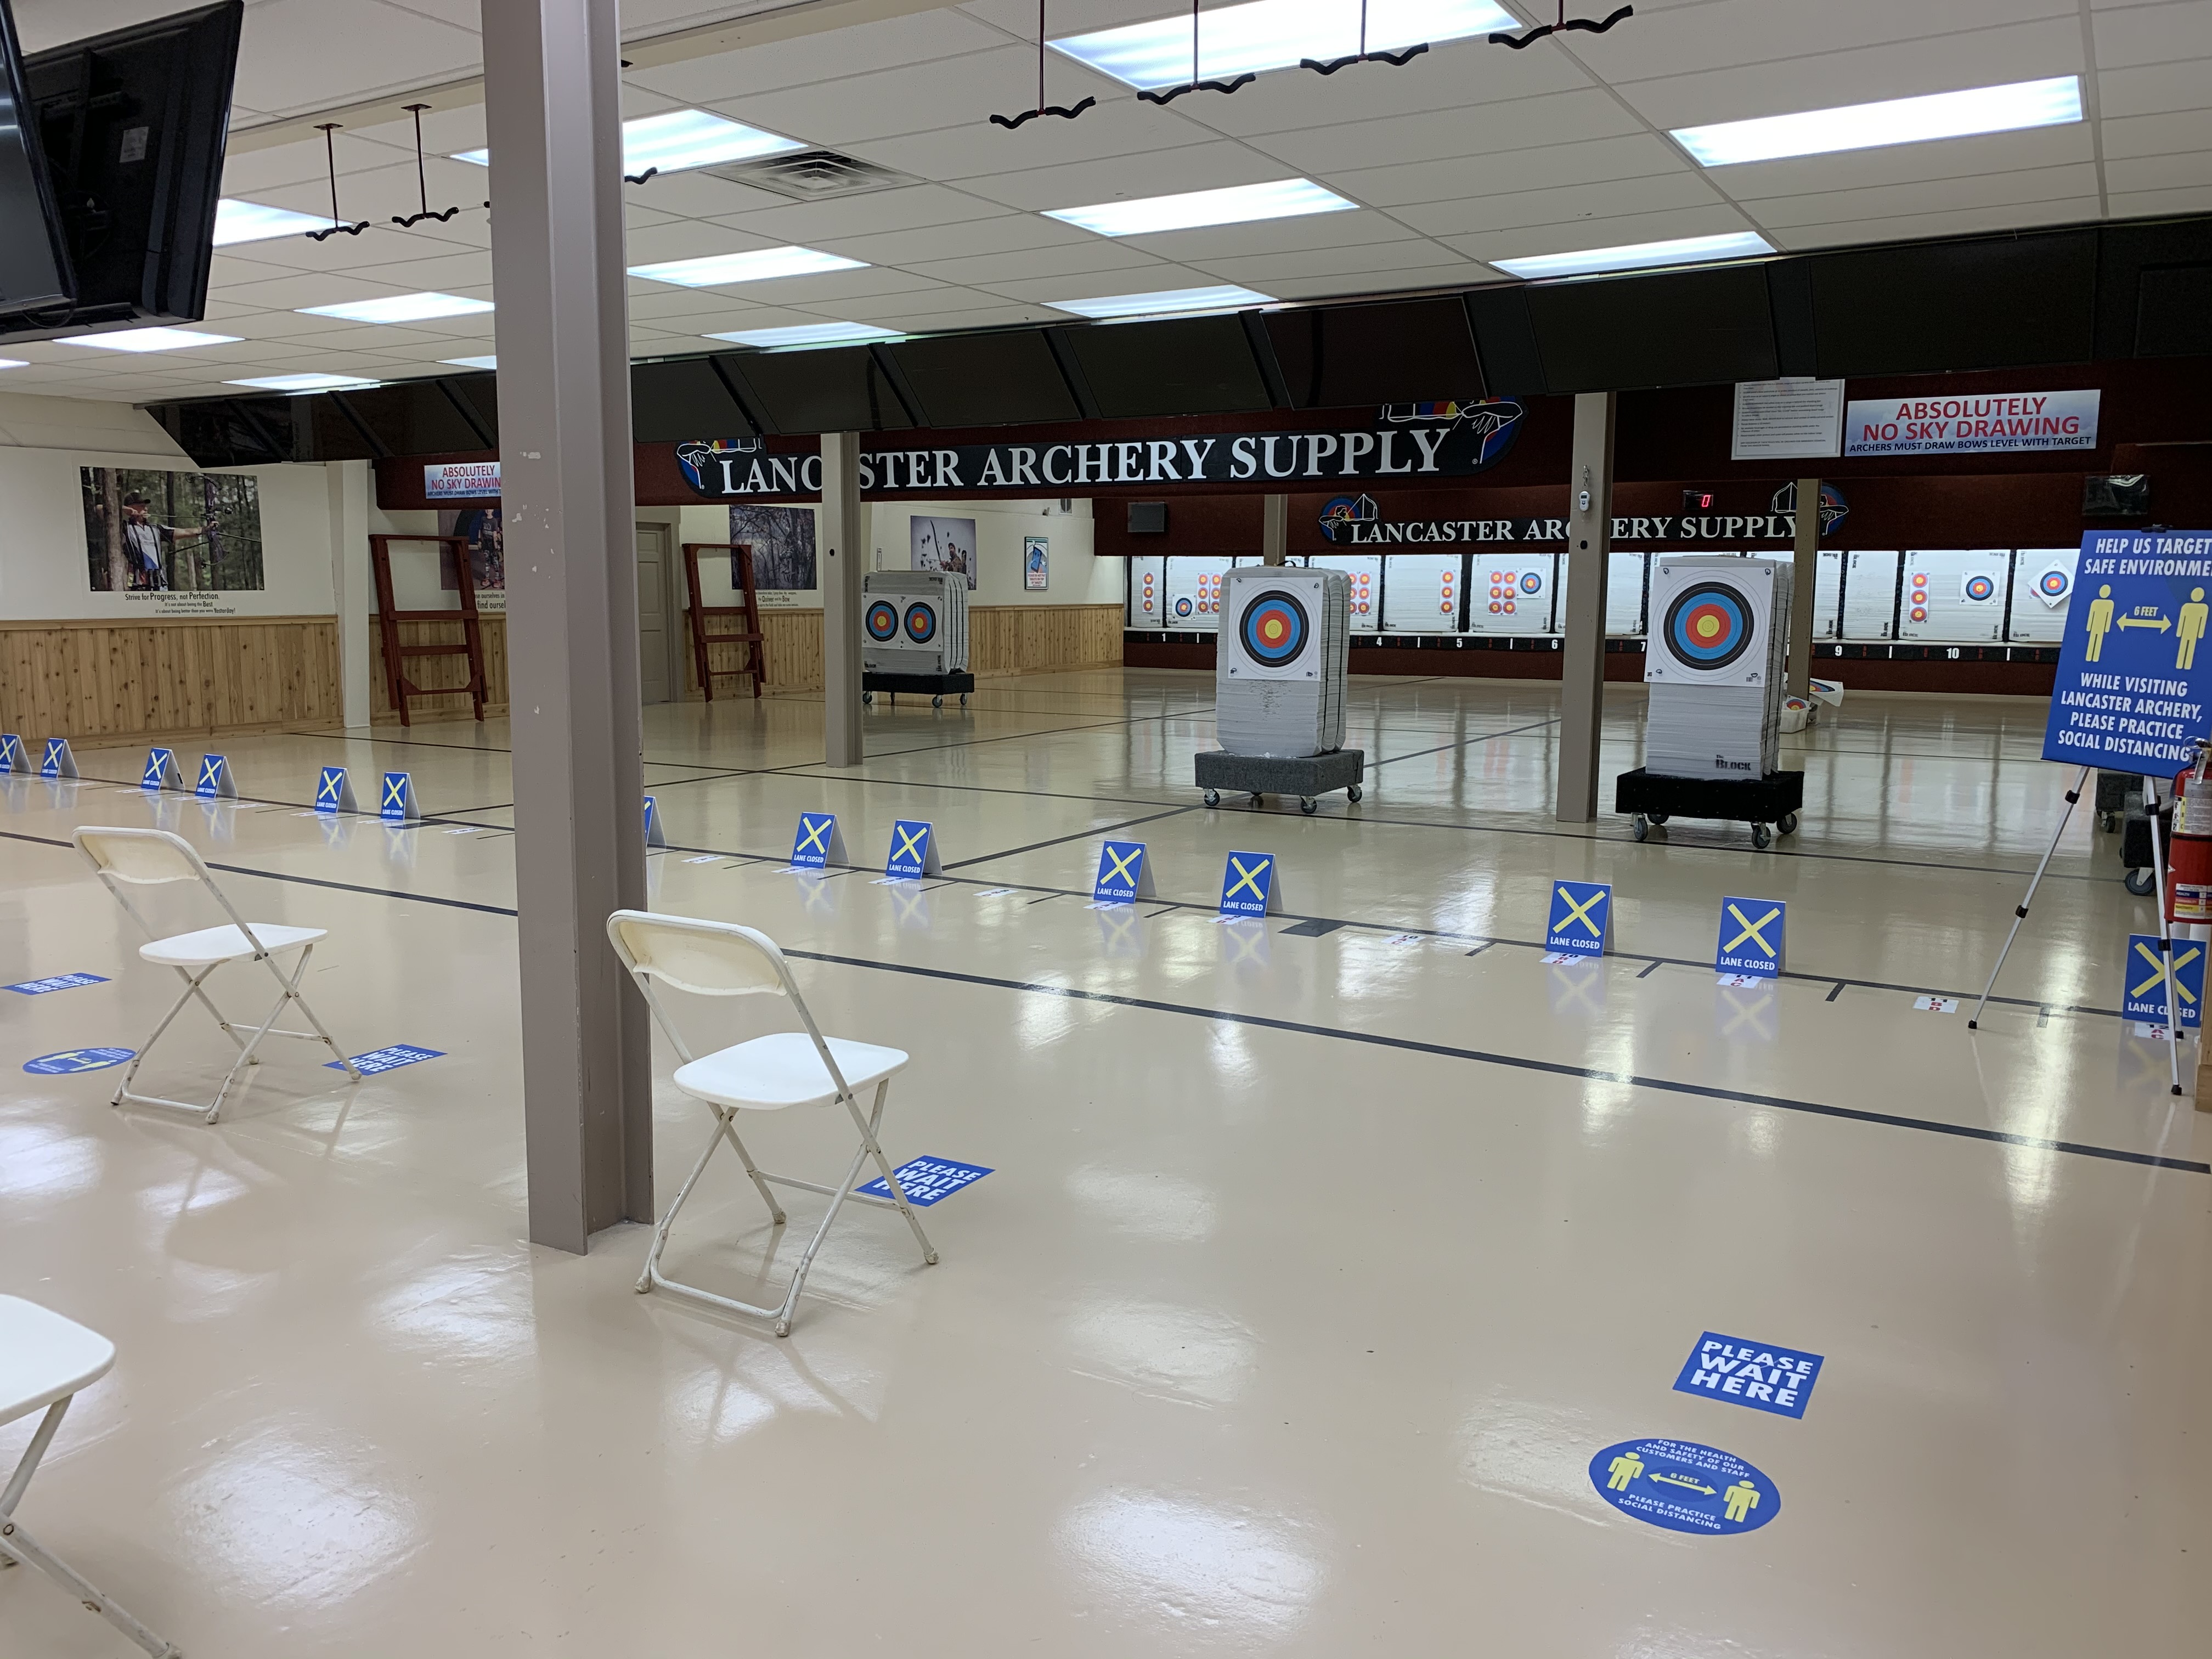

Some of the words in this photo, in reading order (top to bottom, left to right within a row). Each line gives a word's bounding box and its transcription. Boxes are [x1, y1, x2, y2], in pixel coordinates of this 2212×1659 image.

[1896, 397, 2047, 420] ABSOLUTELY
[1863, 423, 1898, 441] NO
[1906, 421, 1949, 439] SKY
[1956, 416, 2080, 438] DRAWING
[1849, 443, 1892, 452] ARCHERS
[1894, 441, 1921, 450] MUST
[1925, 441, 1955, 449] DRAW
[1957, 439, 1988, 448] BOWS
[1990, 438, 2019, 447] LEVEL
[2022, 437, 2049, 446] WITH
[2052, 436, 2091, 445] TARGET
[719, 450, 963, 494] LANCSTER
[977, 439, 1216, 486] ARCHERY
[1230, 428, 1450, 478] SUPPLY
[443, 465, 495, 477] ABSOLUTELY
[432, 479, 444, 490] NO
[447, 478, 462, 489] SKY
[465, 477, 501, 489] DRAWIN
[1701, 495, 1711, 507] 0
[1351, 520, 1514, 543] LANCASTER
[1523, 517, 1672, 540] ARERY
[2096, 538, 2129, 554] HELP
[2132, 538, 2152, 554] US
[2156, 538, 2211, 554] TARGET
[2084, 558, 2116, 574] SAFE
[2119, 559, 2212, 576] ENVIRONME
[150, 592, 178, 602] Progress,
[477, 600, 488, 608] find
[2134, 606, 2140, 616] 6
[2141, 606, 2159, 617] FEET
[1161, 633, 1166, 642] 1
[1376, 637, 1382, 646] 4
[1457, 639, 1463, 648] 5
[1551, 639, 1558, 650] 6
[1641, 642, 1646, 652] 7
[1835, 646, 1842, 656] 9
[1946, 647, 1960, 659] 10
[2081, 672, 2121, 690] WHILE
[2125, 676, 2188, 697] VISITING
[2061, 690, 2132, 712] LANCASTER
[2135, 699, 2203, 723] ARCHERY,
[2070, 712, 2115, 731] PLEASE
[2118, 718, 2184, 740] PRACTICE
[2058, 730, 2100, 749] SOCIAL
[2104, 736, 2190, 762] DISTANCING
[902, 865, 921, 873] CLOSED
[1113, 889, 1134, 898] CLOSED
[1223, 901, 1239, 909] LANE
[1240, 902, 1263, 911] CLOSED
[1550, 936, 1570, 946] LANE
[1572, 939, 1600, 949] CLOSED
[1720, 957, 1742, 967] LANE
[1744, 960, 1775, 970] CLOSED
[2128, 1002, 2154, 1014] LANE
[2158, 1005, 2196, 1018] CLSED
[362, 1052, 416, 1066] WAIT
[380, 1047, 433, 1060] PLEASE
[895, 1168, 966, 1189] WAIT
[907, 1160, 981, 1181] PLEASE
[1702, 1340, 1813, 1374] PLEASE
[1701, 1352, 1807, 1389] WAIT
[1690, 1369, 1798, 1407] HERE
[1645, 1442, 1667, 1451] AND
[1670, 1448, 1705, 1460] SAFETY
[1723, 1462, 1745, 1471] OUR
[1658, 1440, 1677, 1448] FOR
[1680, 1444, 1697, 1453] THE
[1700, 1449, 1736, 1463] HEALTH
[1636, 1446, 1692, 1464] CUSTOMERS
[1696, 1462, 1718, 1470] AND
[1722, 1467, 1750, 1478] STAFF
[1679, 1475, 1700, 1484] FEET
[1618, 1498, 1652, 1512] SOCIAL
[1656, 1509, 1721, 1530] DISTANCING
[1629, 1494, 1664, 1508] PLEASE
[1668, 1504, 1716, 1521] PRACTICE
